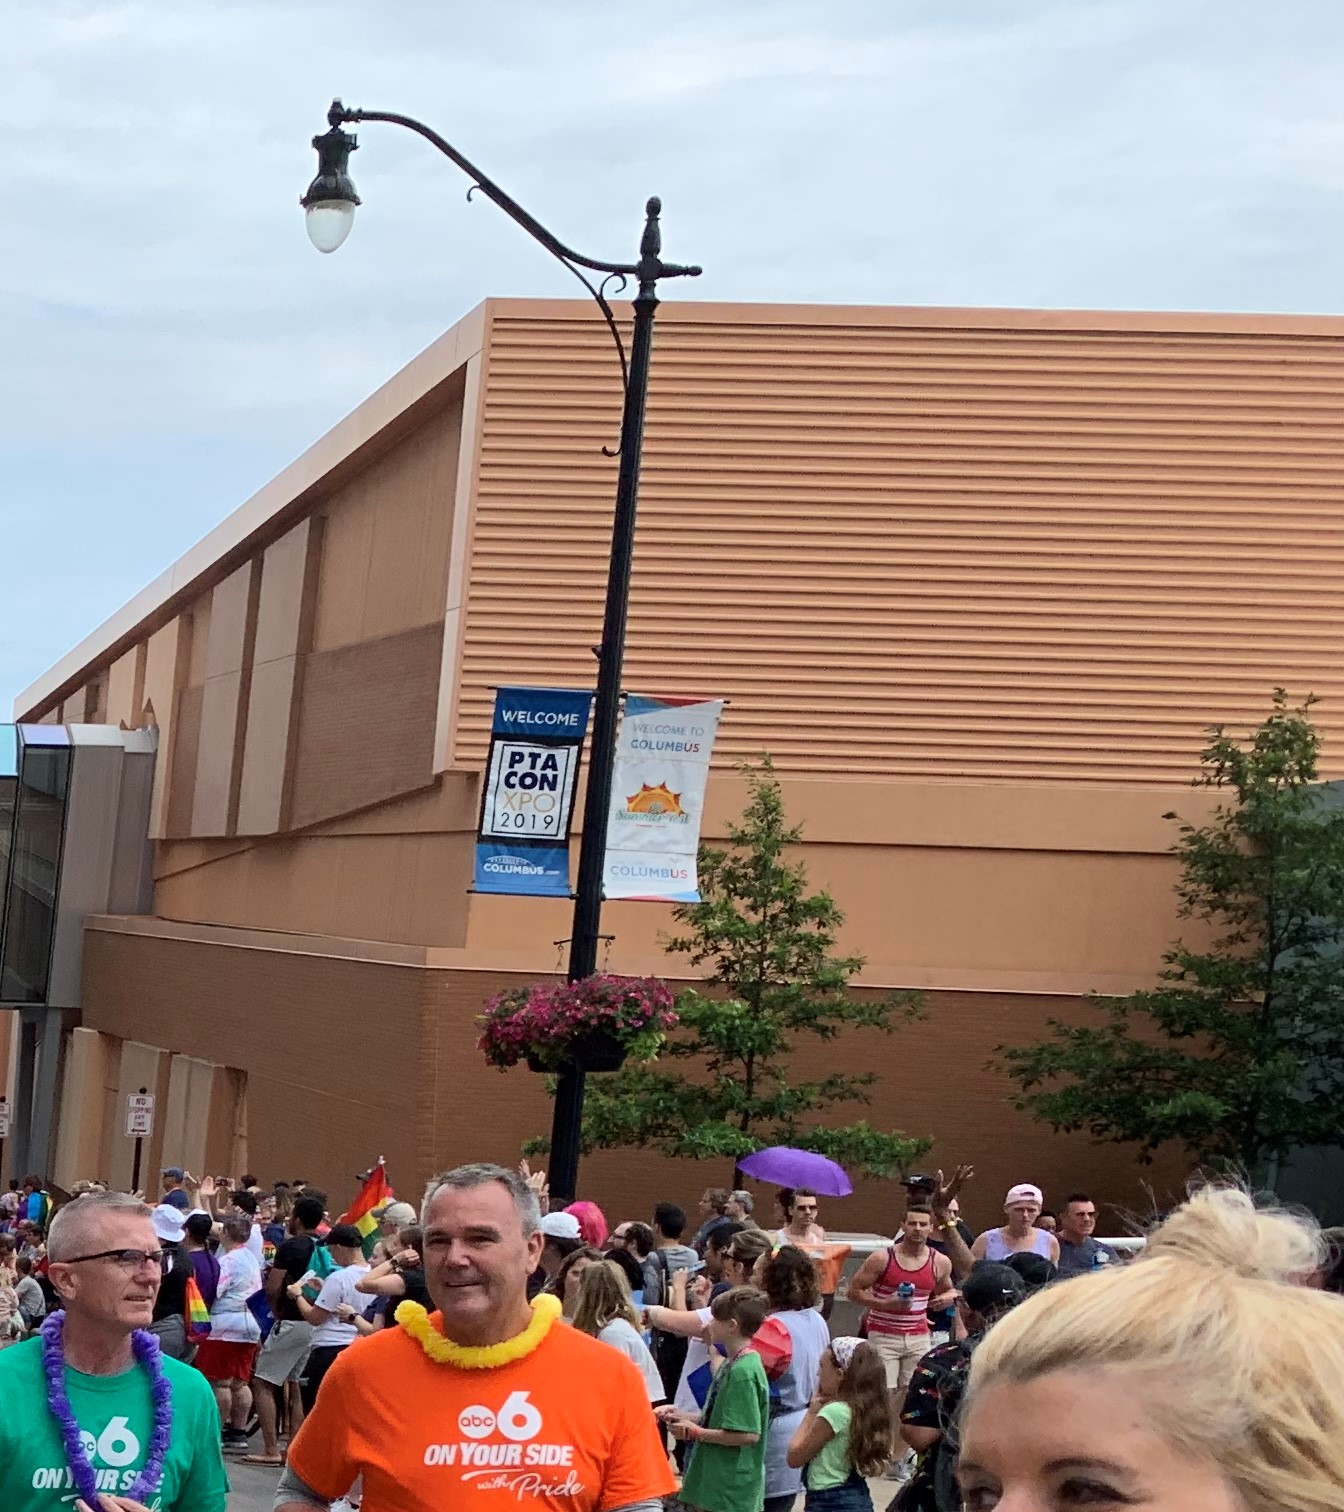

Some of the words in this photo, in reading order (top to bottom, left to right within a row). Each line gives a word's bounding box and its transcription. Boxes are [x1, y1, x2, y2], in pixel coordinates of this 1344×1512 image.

[502, 709, 580, 726] WELCOME
[632, 722, 687, 736] WELCOME
[690, 726, 705, 737] TO
[630, 739, 701, 753] COLUMBUS
[508, 751, 559, 772] PTA
[503, 771, 558, 792] CON
[502, 791, 556, 813] XPO
[501, 812, 554, 830] 2019
[610, 865, 689, 879] COLUMBUS
[135, 1098, 147, 1106] NO
[497, 1390, 543, 1441] 6
[97, 1416, 140, 1467] 6
[423, 1443, 459, 1467] ON
[458, 1442, 525, 1467] YOUR
[524, 1443, 575, 1467] SIDE
[32, 1467, 64, 1489] ON
[477, 1473, 511, 1491] with
[510, 1469, 585, 1501] Pride
